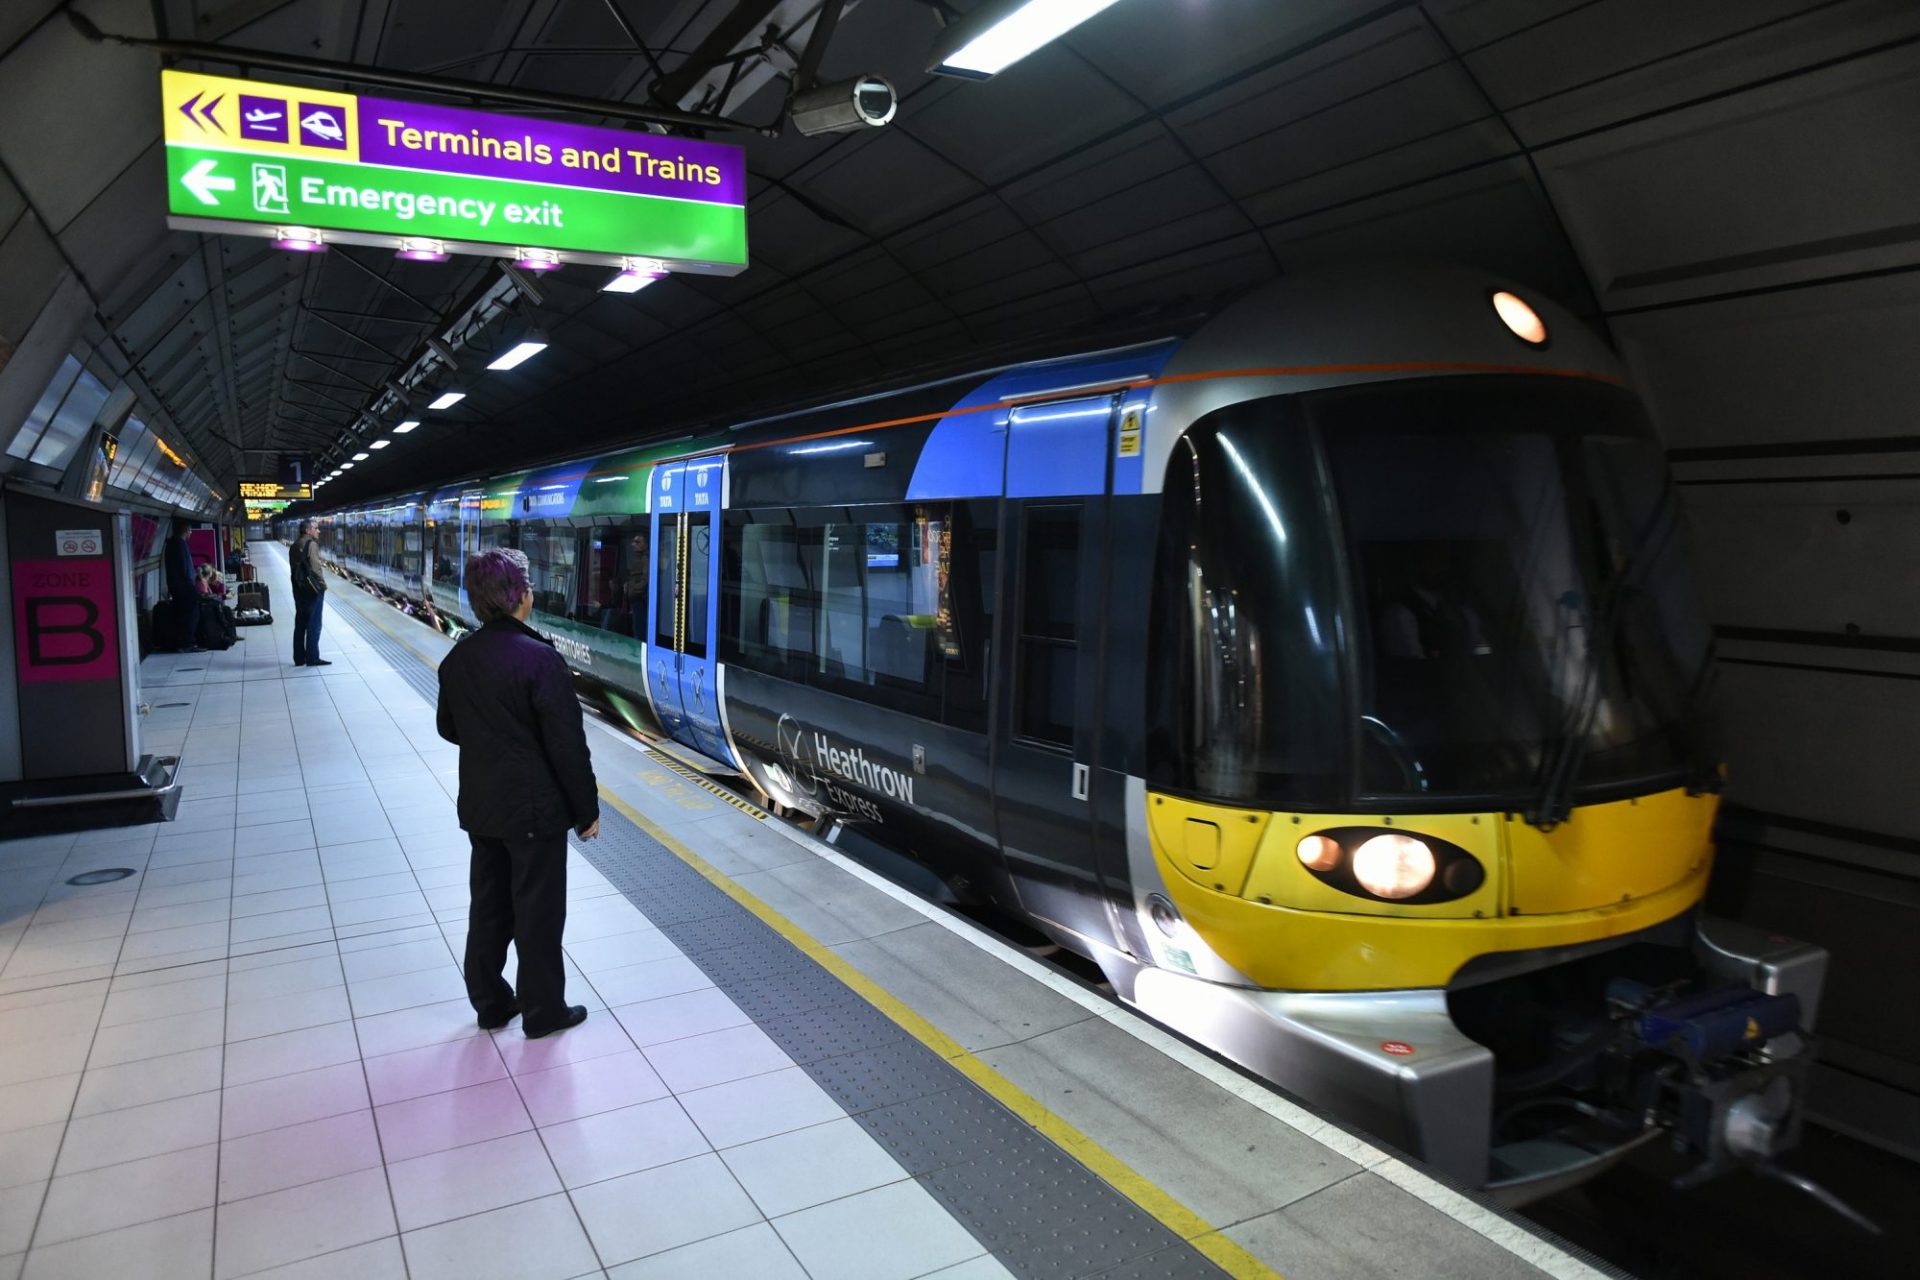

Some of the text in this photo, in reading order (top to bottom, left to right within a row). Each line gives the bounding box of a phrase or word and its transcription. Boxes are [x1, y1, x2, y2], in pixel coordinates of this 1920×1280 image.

[378, 118, 722, 186] Terminals and Trains
[301, 179, 564, 228] Emergency exit
[289, 461, 303, 483] 1
[660, 495, 673, 508] TATA
[695, 492, 709, 506] TATA
[32, 572, 91, 588] ZONE
[25, 595, 105, 667] B
[814, 731, 914, 805] Heathrow
[812, 774, 884, 824] Express
